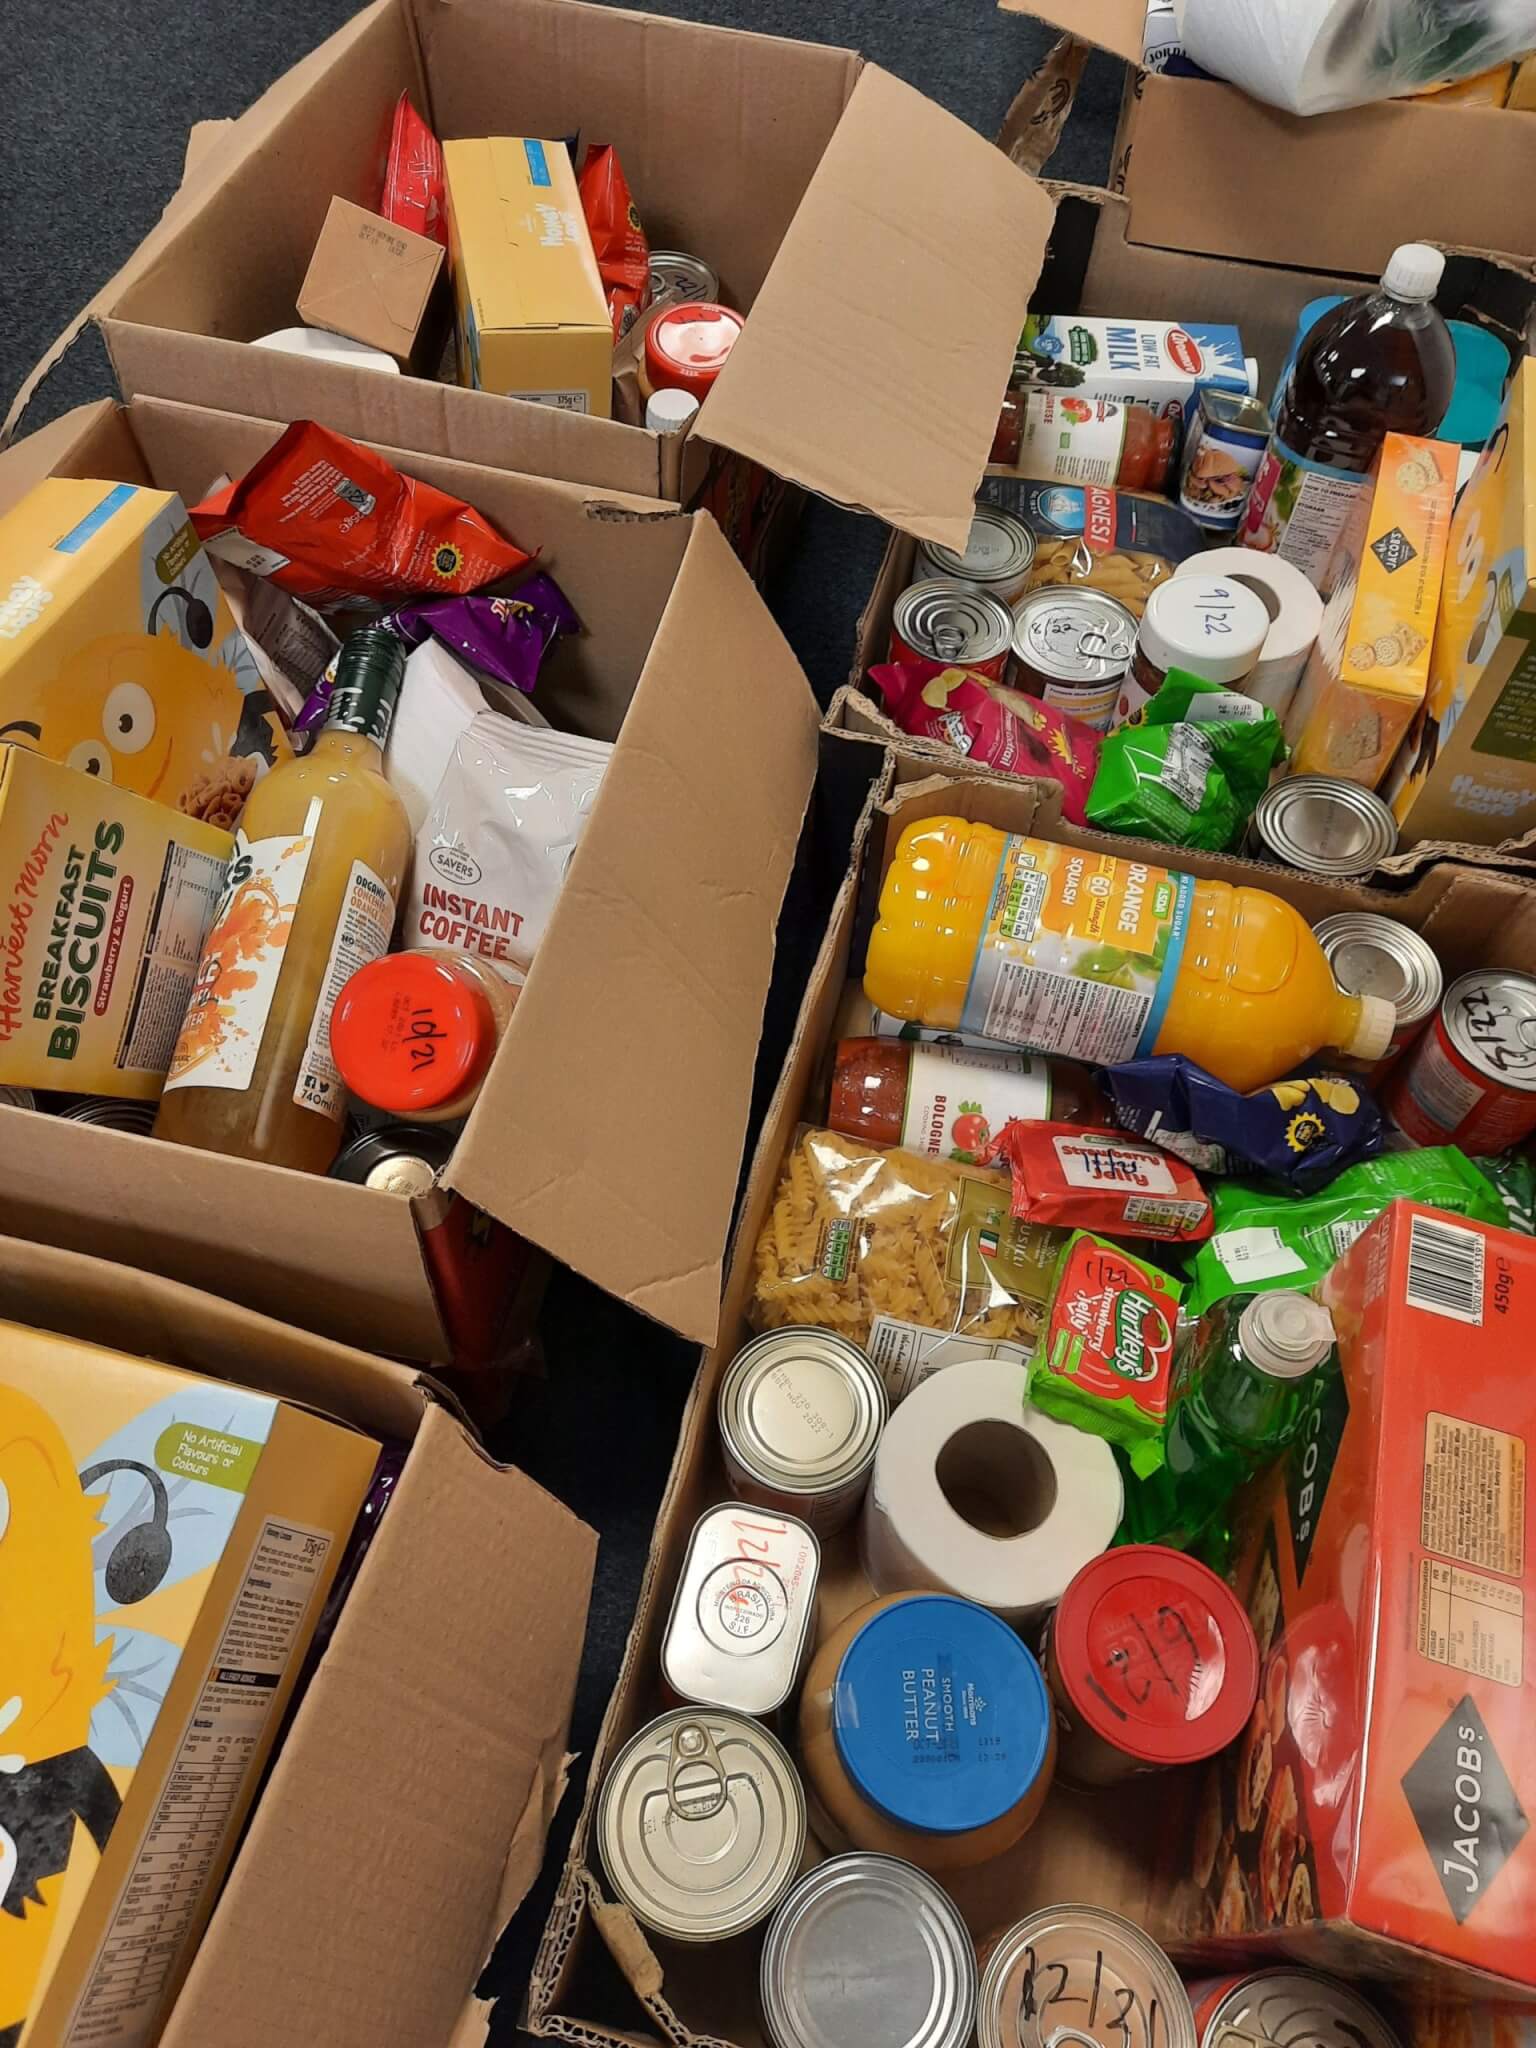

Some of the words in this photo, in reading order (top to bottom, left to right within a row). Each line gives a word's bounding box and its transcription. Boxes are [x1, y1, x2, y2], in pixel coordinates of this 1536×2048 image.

[1105, 326, 1141, 372] MILK
[1141, 333, 1157, 351] LOW
[1143, 352, 1161, 370] FAT
[1090, 488, 1112, 543] AGNESI
[1194, 588, 1236, 635] 9/22
[999, 730, 1016, 767] Cocktail
[15, 812, 70, 899] Morn
[437, 854, 474, 879] SAVERS
[1061, 856, 1085, 906] SQUASH
[1089, 875, 1111, 898] 60
[1117, 863, 1149, 936] ORANGE
[1155, 886, 1170, 914] ASDA
[33, 844, 86, 1020] BREAKFAST
[423, 883, 524, 937] INSTANT
[1089, 897, 1107, 937] Strength
[47, 820, 125, 1060] BISCUITS
[96, 938, 121, 1010] Strawberry
[114, 881, 132, 926] Yogurt
[420, 910, 511, 961] COFFEE
[0, 902, 34, 1041] Harvest
[1073, 982, 1089, 1017] NUTRITION
[1131, 997, 1150, 1038] INGREDIENTS
[927, 1095, 948, 1161] BOLOGNE
[1061, 1145, 1161, 1167] Strawberry
[1494, 1273, 1514, 1314] 450g
[1089, 1286, 1116, 1352] strawberry
[1115, 1291, 1154, 1377] Hartley's
[172, 1456, 210, 1476] Colours
[177, 1443, 219, 1465] Flavours
[222, 1458, 235, 1468] or
[182, 1430, 197, 1443] No
[198, 1435, 244, 1457] Artificial
[729, 1590, 764, 1611] BRASIL
[902, 1670, 920, 1741] BUTTER
[921, 1668, 939, 1742] PEANUT
[942, 1677, 955, 1731] SMOOTH
[967, 1683, 978, 1726] Morrisons
